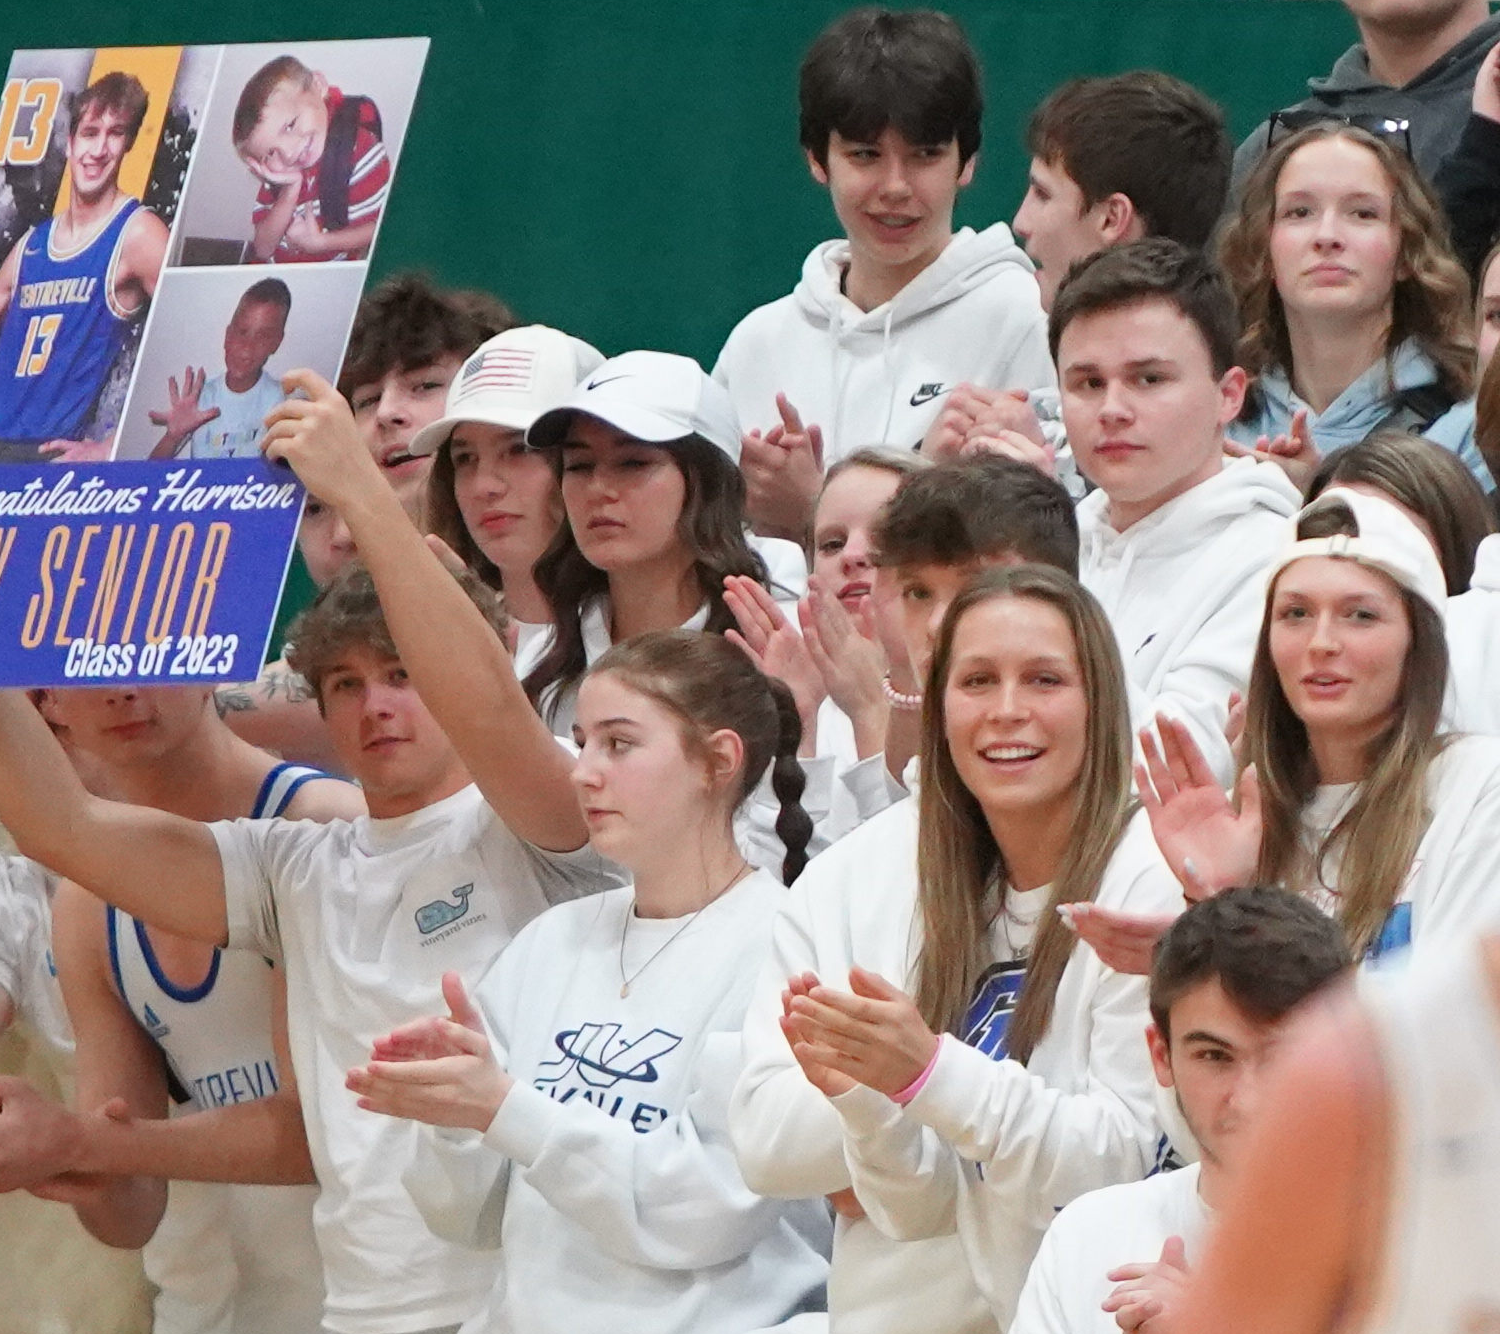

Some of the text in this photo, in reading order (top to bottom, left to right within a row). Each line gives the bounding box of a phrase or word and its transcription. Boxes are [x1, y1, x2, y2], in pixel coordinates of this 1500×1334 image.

[14, 313, 64, 378] 13
[151, 467, 297, 512] Harrison
[21, 521, 233, 649] SENIOR
[63, 634, 238, 678] Class of 2023
[420, 912, 488, 948] vineyard vines
